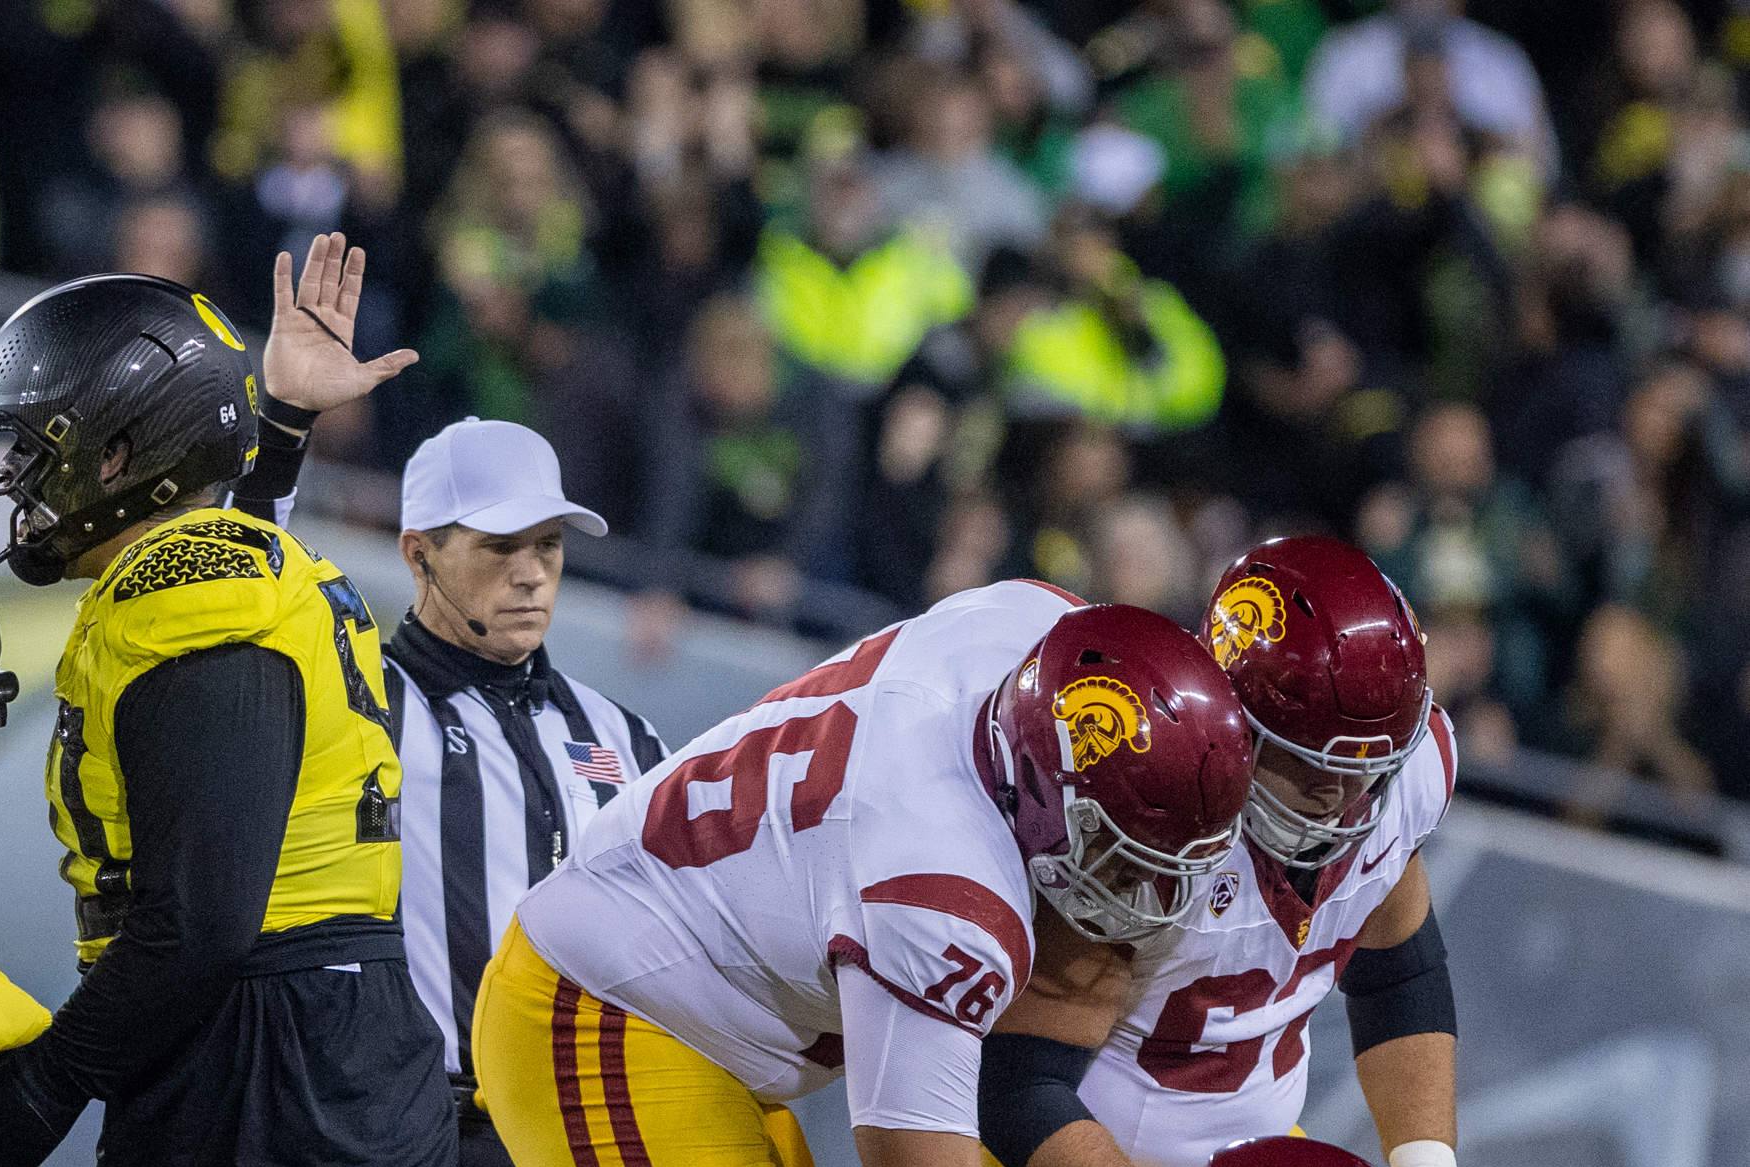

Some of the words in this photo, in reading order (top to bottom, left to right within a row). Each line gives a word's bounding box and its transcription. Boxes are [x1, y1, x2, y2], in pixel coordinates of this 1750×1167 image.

[219, 403, 237, 424] 64
[641, 626, 905, 870] 76
[1213, 891, 1230, 909] 12
[924, 942, 1007, 1024] 76
